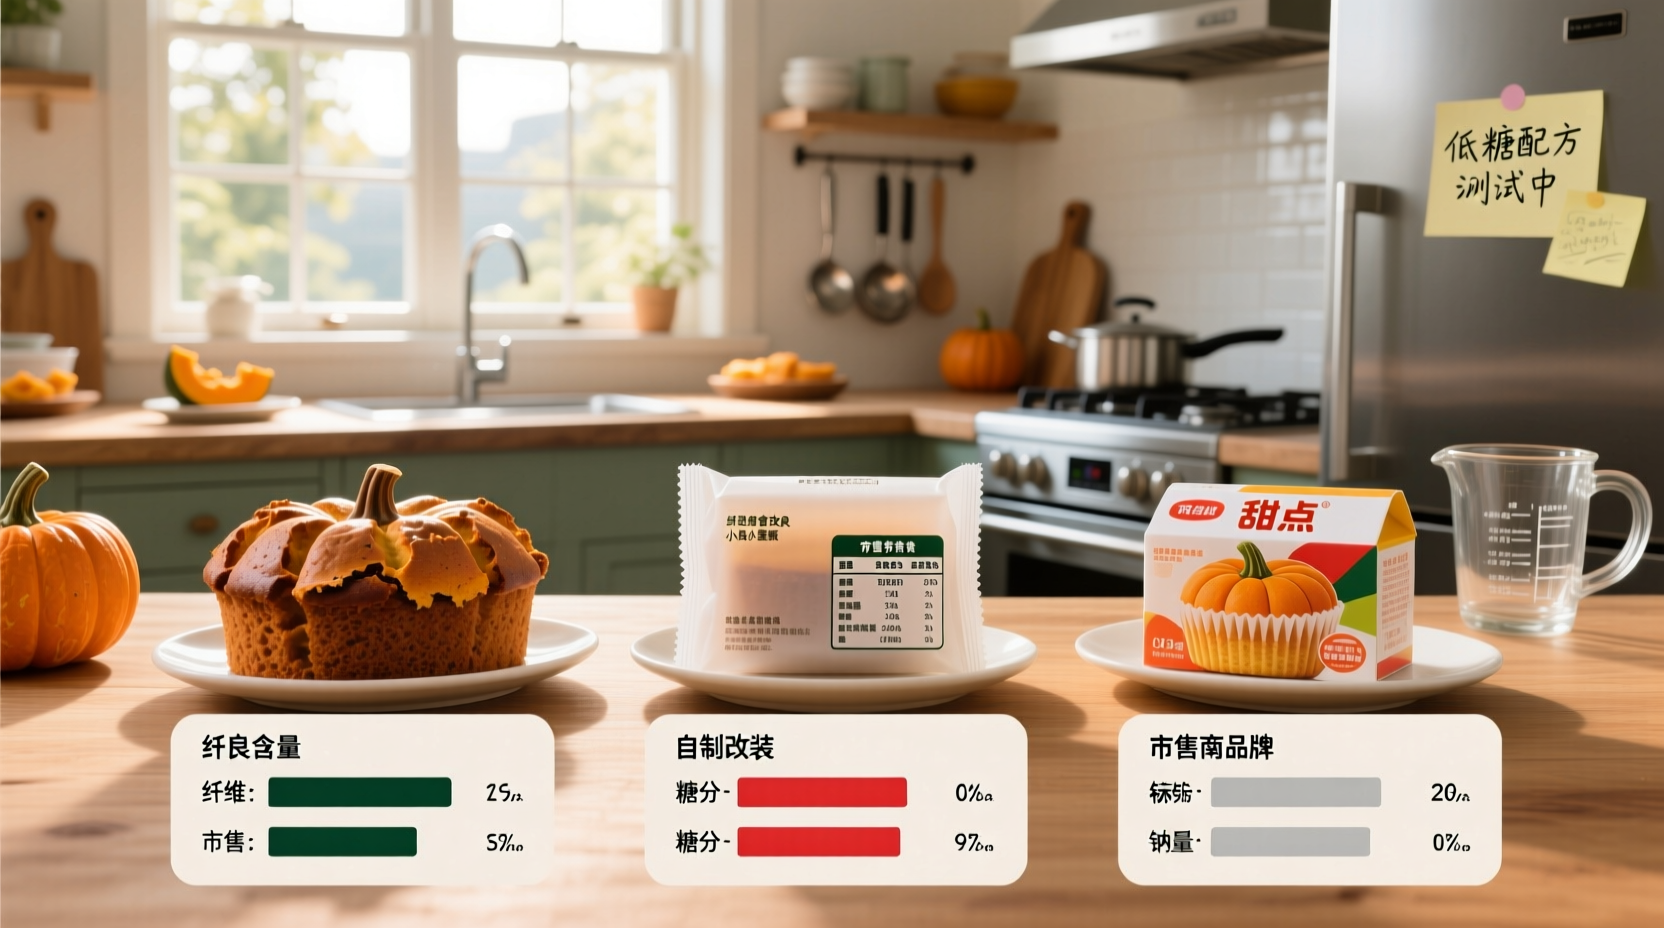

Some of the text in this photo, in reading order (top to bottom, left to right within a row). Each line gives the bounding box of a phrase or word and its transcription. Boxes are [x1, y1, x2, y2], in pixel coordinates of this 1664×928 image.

[1444, 122, 1582, 163] 低糖配方
[1456, 167, 1556, 208] 测试中
[1238, 499, 1318, 533] 甜点
